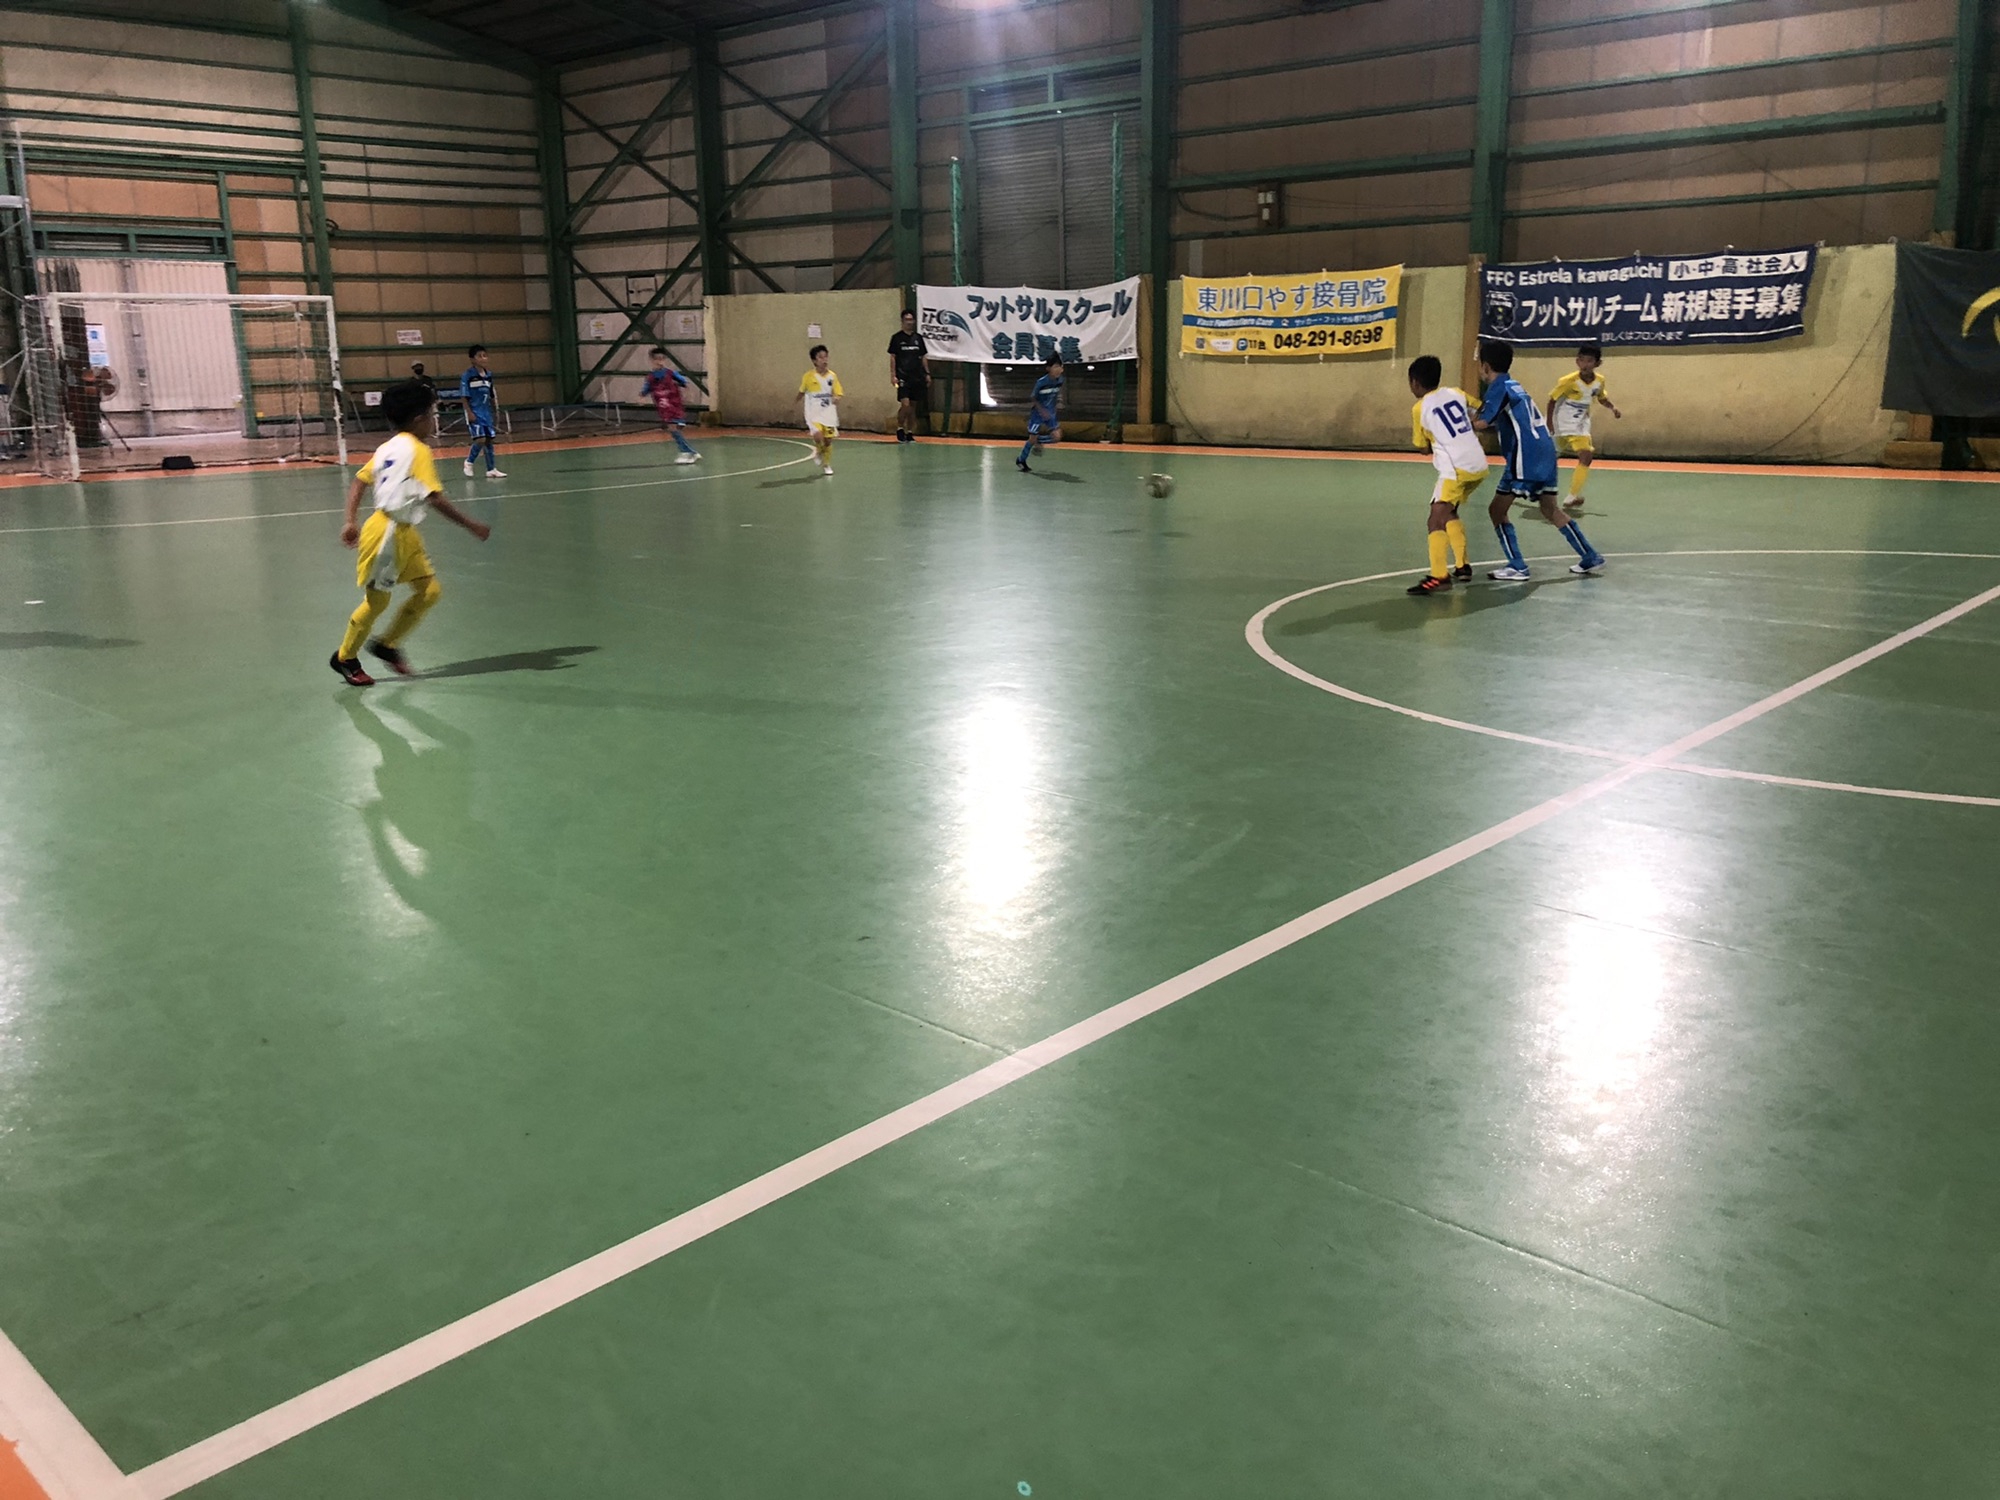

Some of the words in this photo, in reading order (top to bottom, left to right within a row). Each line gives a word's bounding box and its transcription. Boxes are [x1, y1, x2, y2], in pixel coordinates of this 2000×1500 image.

[1487, 271, 1515, 287] FFC
[1519, 268, 1573, 285] Estrela
[1577, 263, 1663, 283] kawaguchi
[967, 289, 1133, 326] フットサルスクール
[1198, 279, 1387, 312] 東川口やす接骨院
[992, 331, 1083, 363] 会員募集
[1274, 326, 1384, 350] 048-291-8698
[482, 393, 489, 404] 7
[1432, 399, 1471, 438] 19
